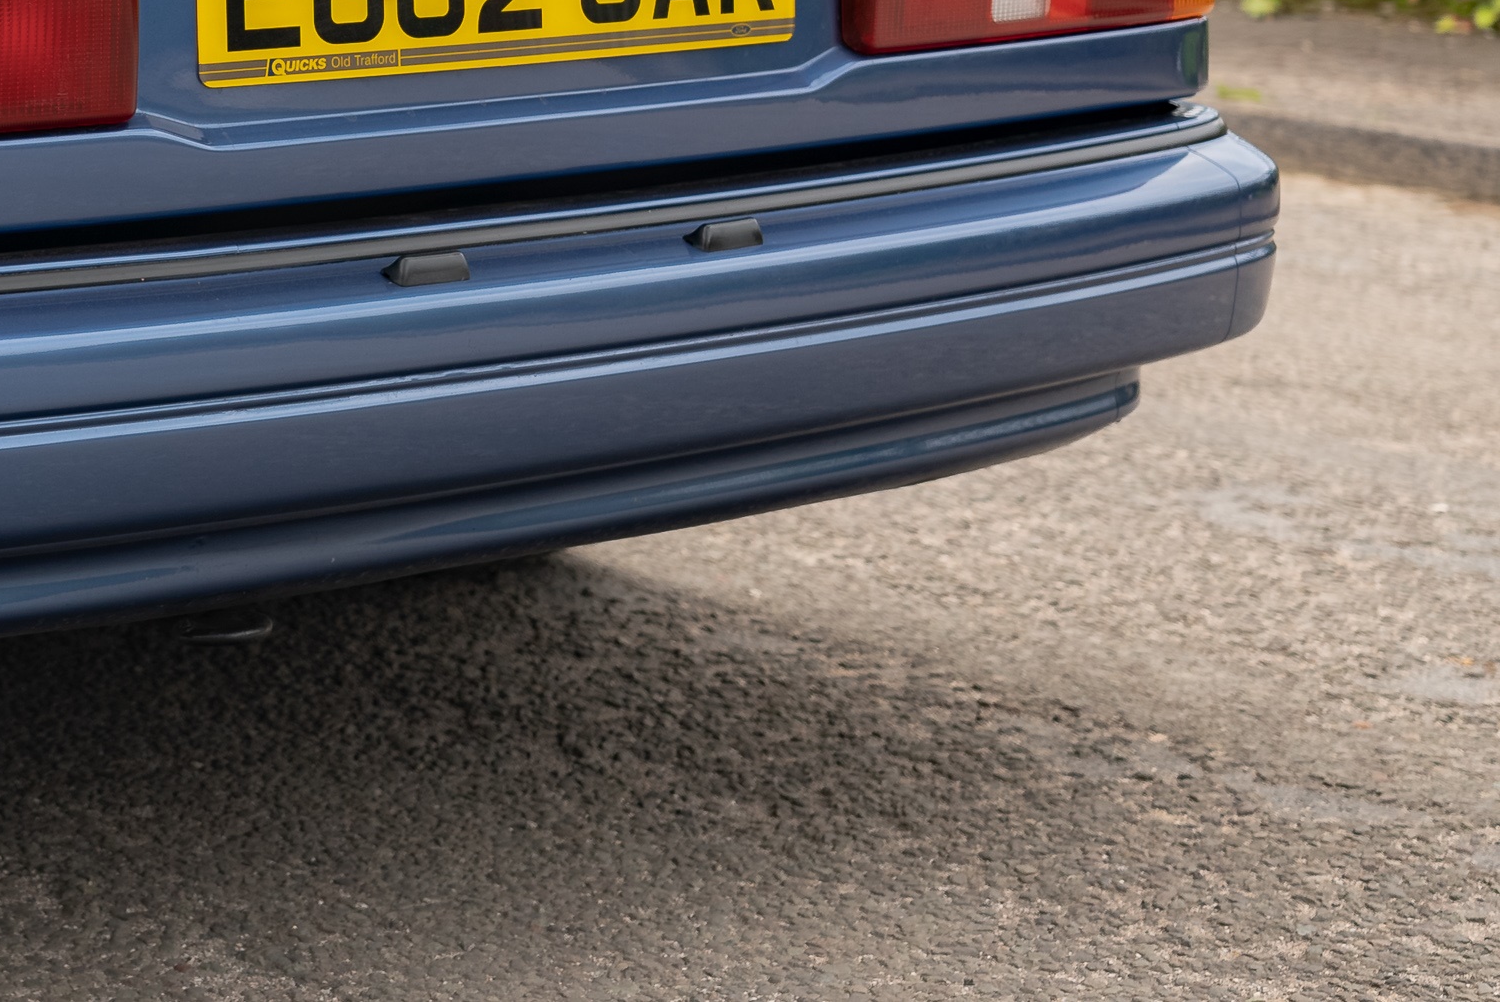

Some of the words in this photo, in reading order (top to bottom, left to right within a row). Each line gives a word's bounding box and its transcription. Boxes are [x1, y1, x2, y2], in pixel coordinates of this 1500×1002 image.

[271, 58, 327, 76] QUICKS
[331, 56, 351, 68] Old
[354, 52, 396, 66] Trafford
